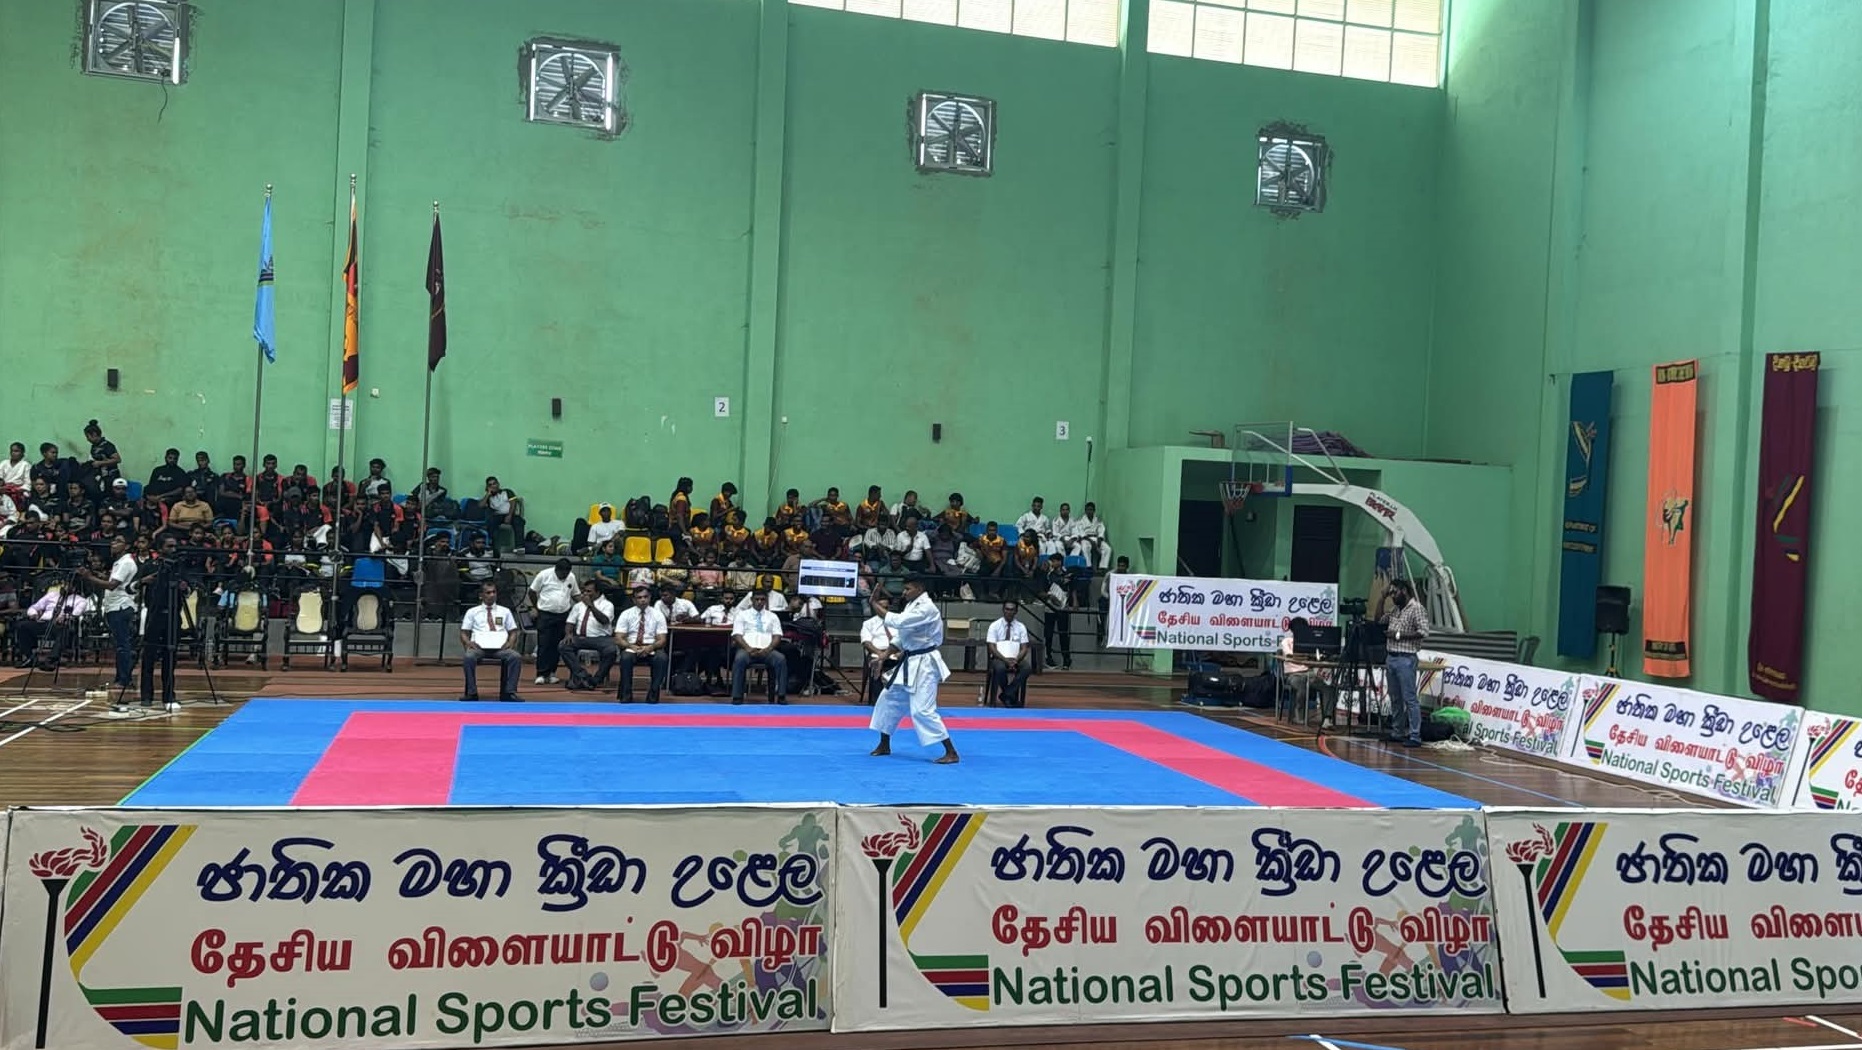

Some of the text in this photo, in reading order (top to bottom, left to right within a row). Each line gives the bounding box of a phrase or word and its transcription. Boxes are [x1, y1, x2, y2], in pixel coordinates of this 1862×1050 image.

[719, 402, 726, 413] 2
[1059, 425, 1066, 436] 3
[1158, 630, 1218, 645] National
[1223, 631, 1271, 648] Sports
[1475, 722, 1510, 744] Sports
[1512, 731, 1558, 756] Festival
[1602, 748, 1777, 804] National Sports Festival
[197, 838, 371, 903] ජාතික
[393, 848, 510, 900] මහා
[672, 853, 822, 908] උළෙල
[991, 826, 1126, 884] ජාතික
[1140, 837, 1234, 883] මහා
[1362, 847, 1486, 896] උළෙල
[1616, 833, 1729, 886] ජාතික
[1740, 842, 1818, 884] මහා
[191, 917, 822, 988] தேசிய விளையாட்டு விழா
[992, 903, 1489, 956] தேசிய விளையாட்டு விழா
[1624, 905, 1729, 951] தேசிய
[994, 962, 1493, 1010] National Sports Festival
[1630, 957, 1862, 999] National Spo
[184, 980, 817, 1045] National Sports Festival
